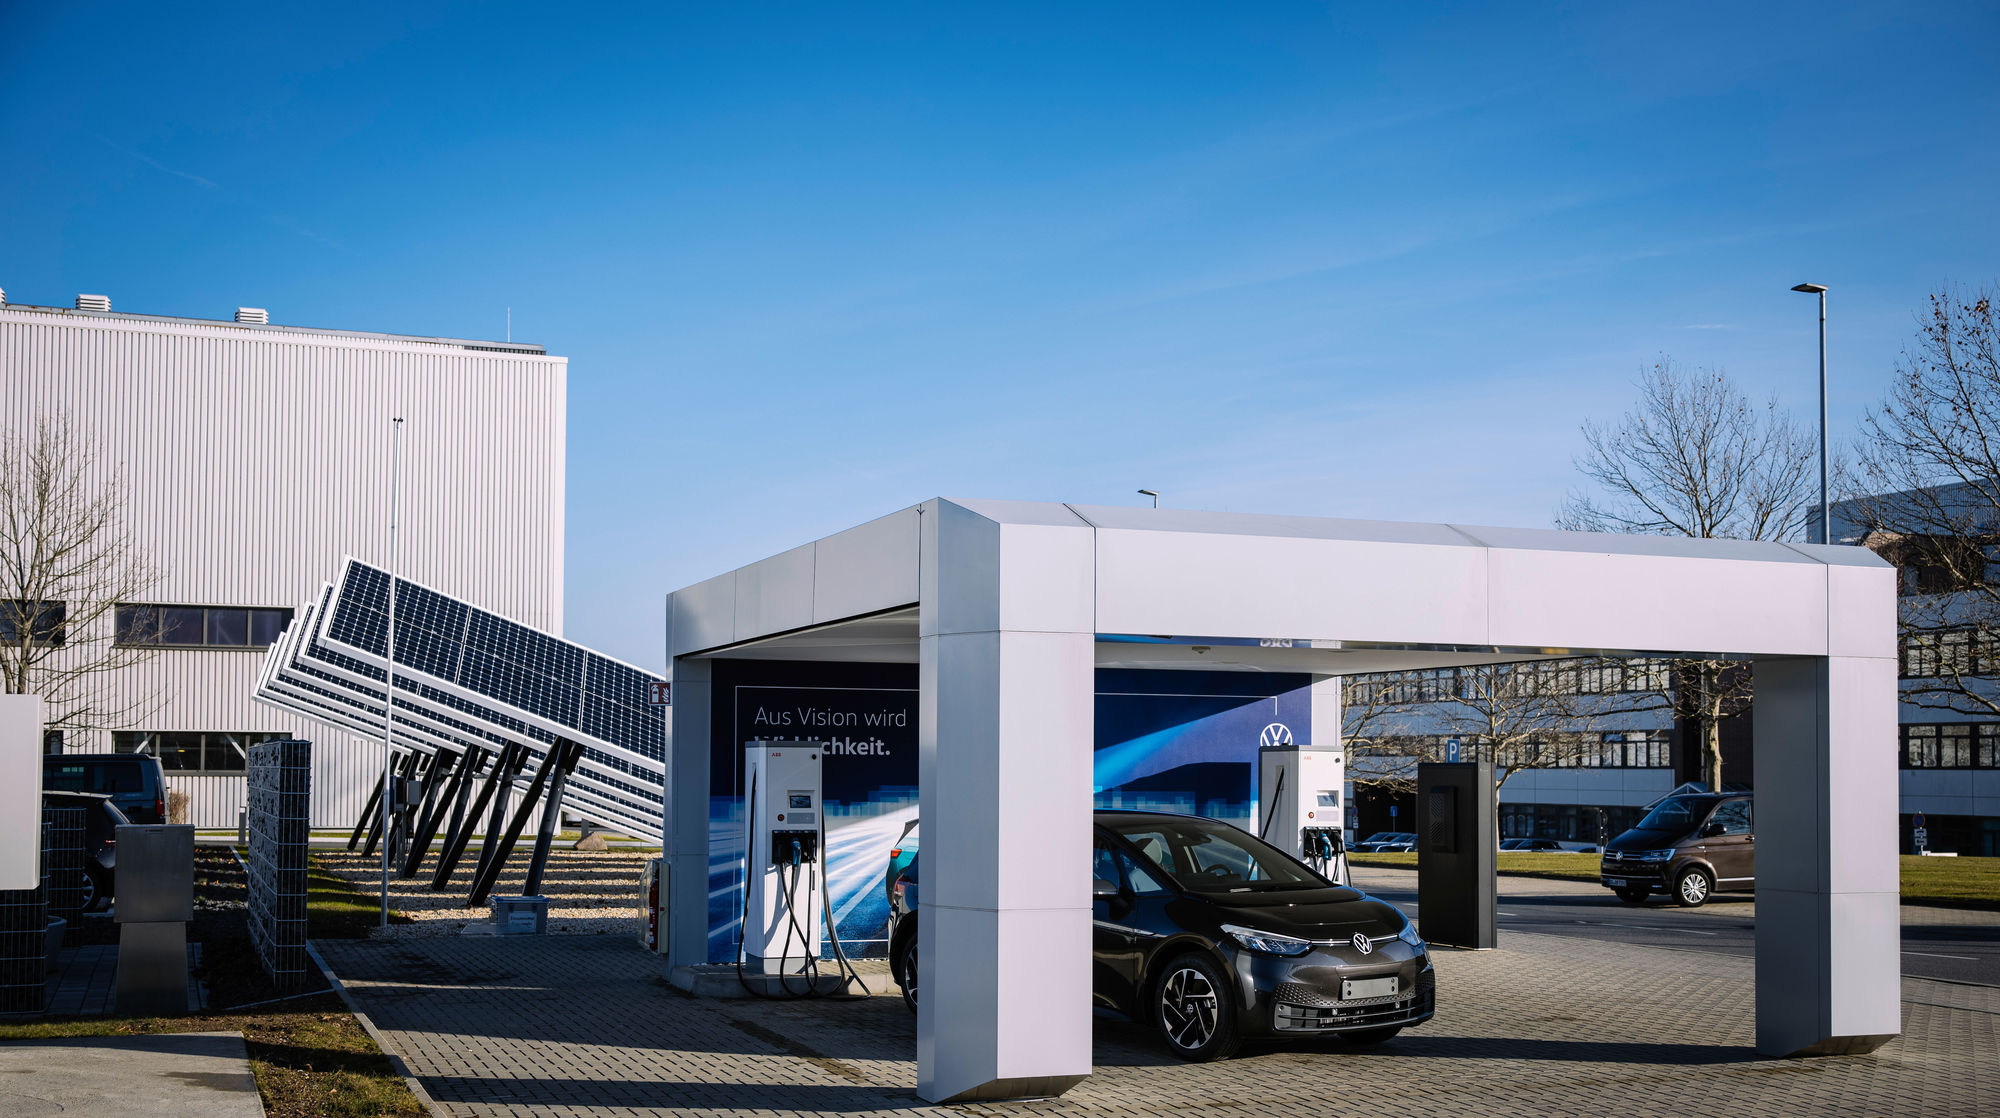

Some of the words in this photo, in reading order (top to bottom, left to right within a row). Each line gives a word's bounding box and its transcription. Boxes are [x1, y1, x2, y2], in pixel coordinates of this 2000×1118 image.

[754, 706, 792, 726] Aus
[797, 707, 857, 726] Vision
[864, 708, 907, 727] wird
[1449, 742, 1458, 761] P
